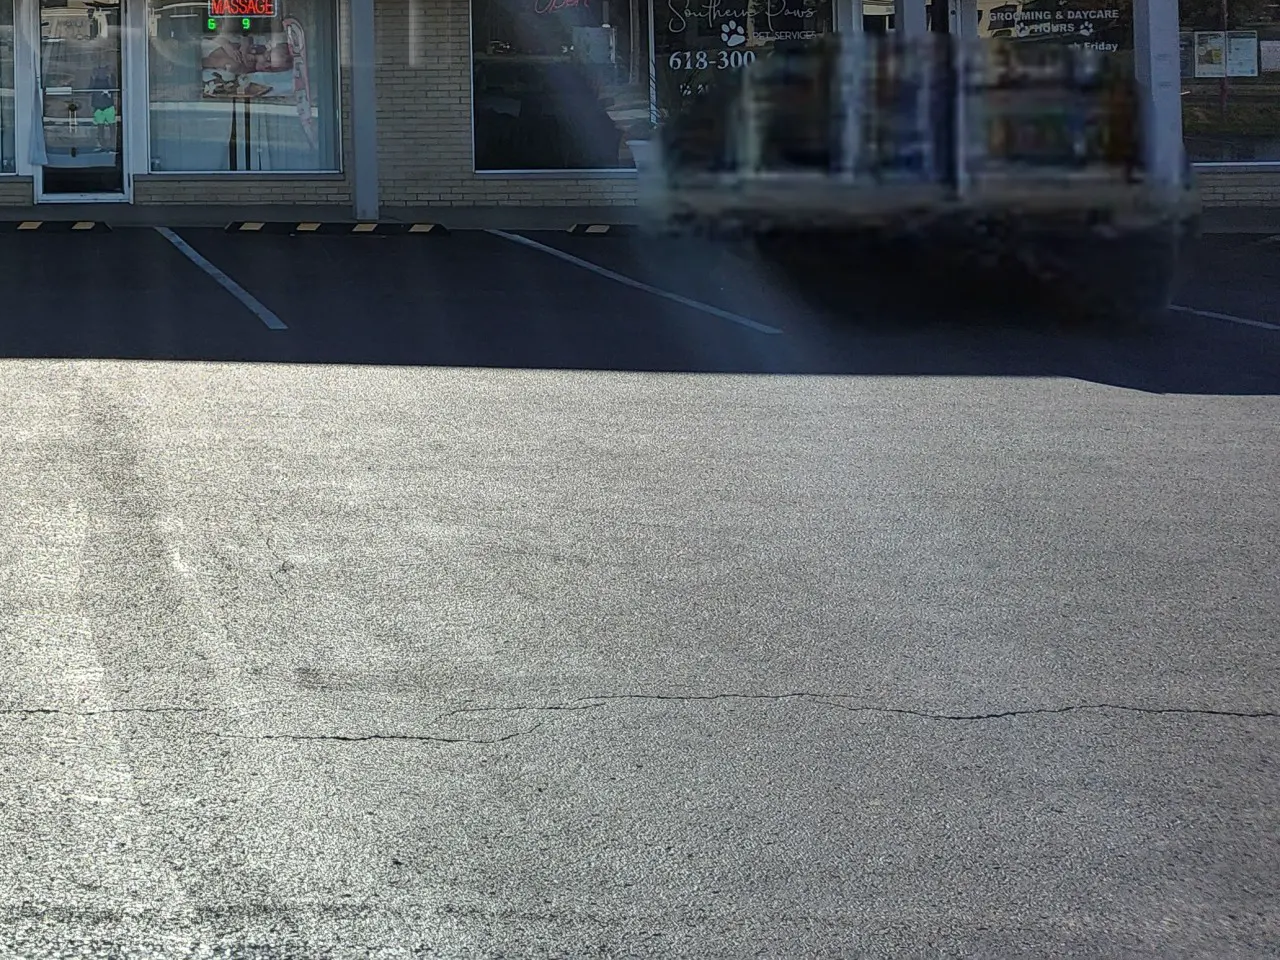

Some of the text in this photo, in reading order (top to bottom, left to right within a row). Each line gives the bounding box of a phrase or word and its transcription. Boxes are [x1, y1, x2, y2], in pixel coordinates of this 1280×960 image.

[988, 9, 1120, 22] GROOMING & DAYCARE
[1034, 22, 1075, 33] HOURS
[774, 30, 817, 40] SERVICES
[1084, 42, 1118, 53] Friday
